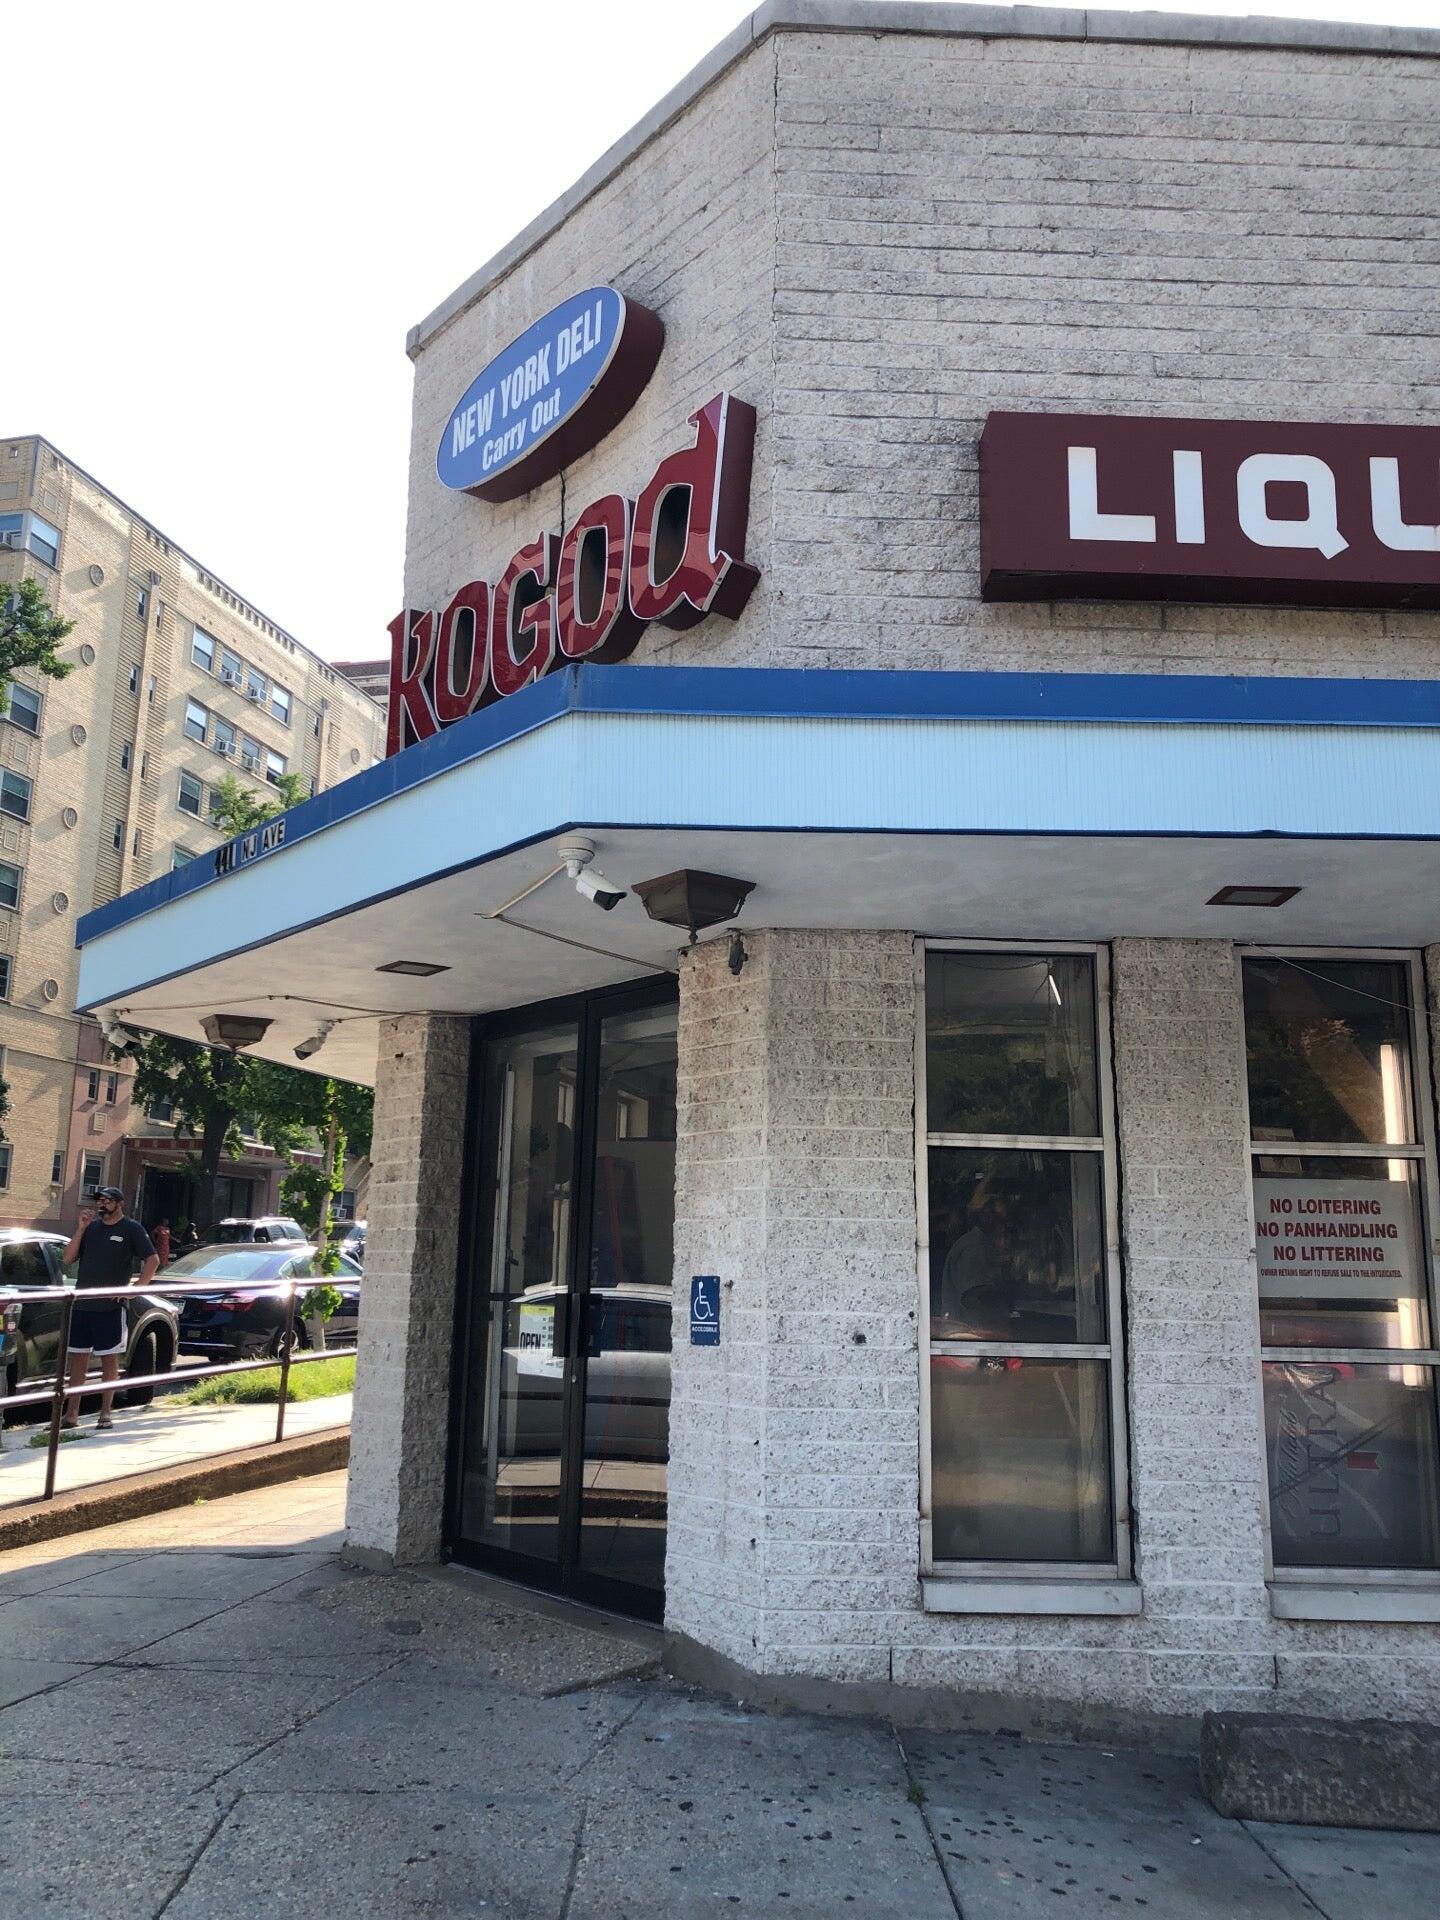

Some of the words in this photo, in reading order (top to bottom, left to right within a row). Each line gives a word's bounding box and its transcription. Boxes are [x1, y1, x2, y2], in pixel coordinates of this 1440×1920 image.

[452, 387, 496, 458] NEW
[500, 341, 551, 419] YORK
[556, 301, 602, 377] DELI
[482, 418, 528, 471] Carry
[530, 387, 561, 434] Out
[1067, 446, 1440, 560] LIQU
[242, 834, 257, 861] NJ
[263, 820, 285, 850] AVE
[1269, 1198, 1293, 1214] NO
[1297, 1198, 1382, 1215] LOITERING
[1256, 1221, 1280, 1237] NO
[1284, 1222, 1398, 1239] PANHANDLING
[1273, 1245, 1297, 1261] NO
[1301, 1246, 1385, 1262] LITTERING
[1260, 1268, 1278, 1277] OWNER
[1299, 1268, 1313, 1277] RIGHT
[1314, 1269, 1321, 1277] TO
[1321, 1269, 1340, 1278] REFUSE
[1340, 1269, 1353, 1278] SALE
[1353, 1269, 1360, 1278] TO
[520, 1331, 542, 1352] OPEN
